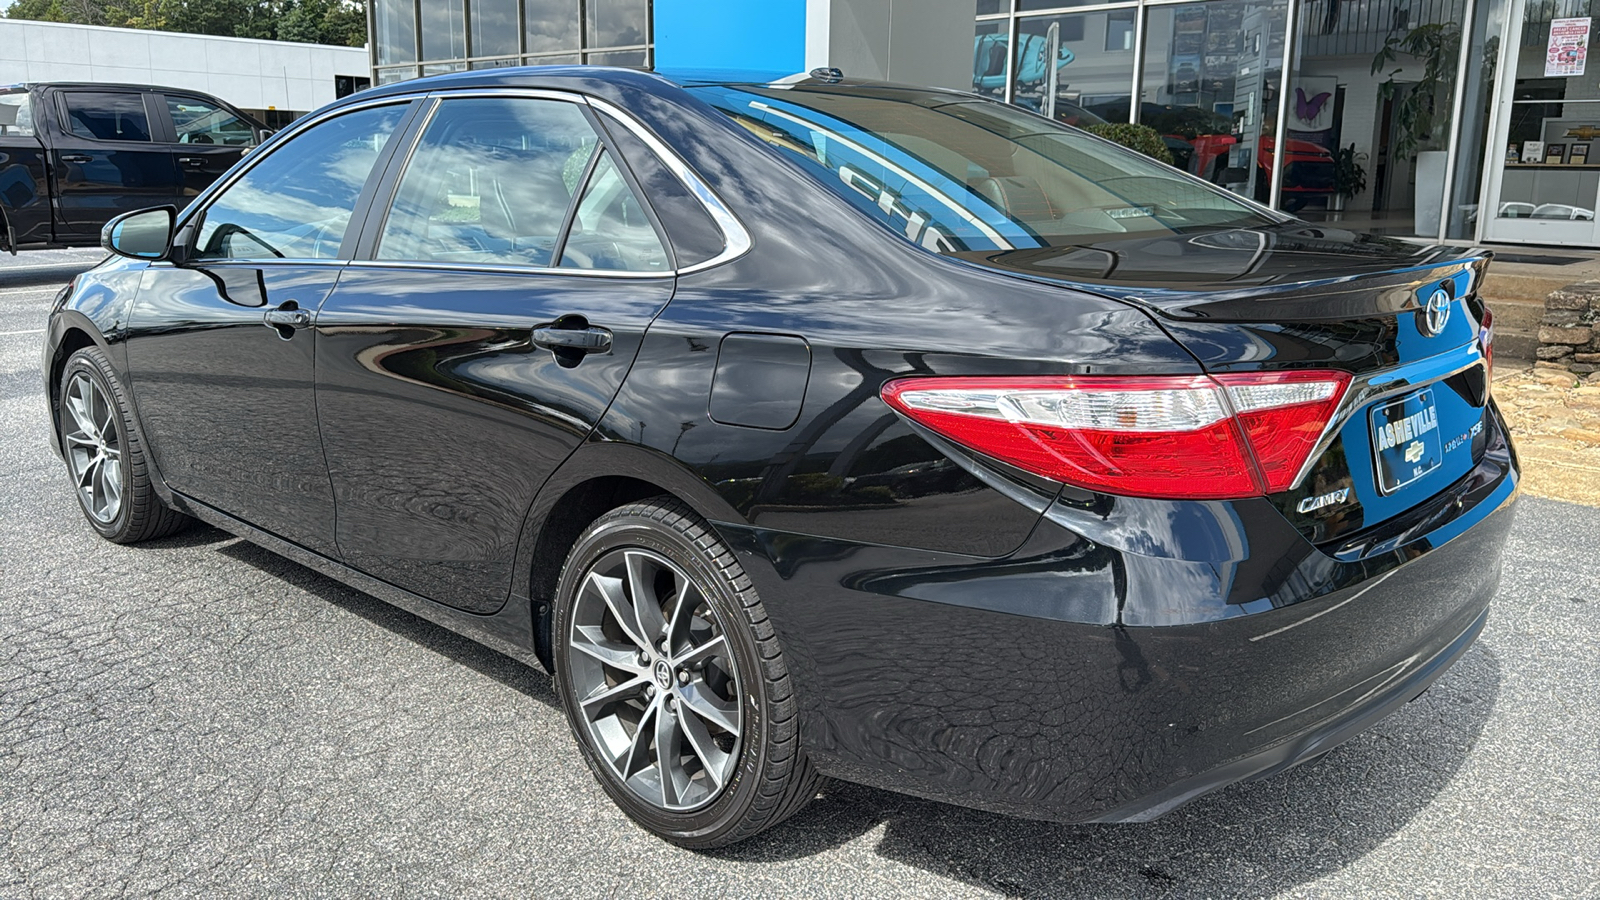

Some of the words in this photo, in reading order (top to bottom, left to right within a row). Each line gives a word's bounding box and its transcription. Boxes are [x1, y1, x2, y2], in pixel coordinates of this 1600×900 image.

[1378, 405, 1438, 452] ASHEVILLE
[1469, 420, 1483, 439] XSE
[1296, 487, 1350, 514] CAMRY
